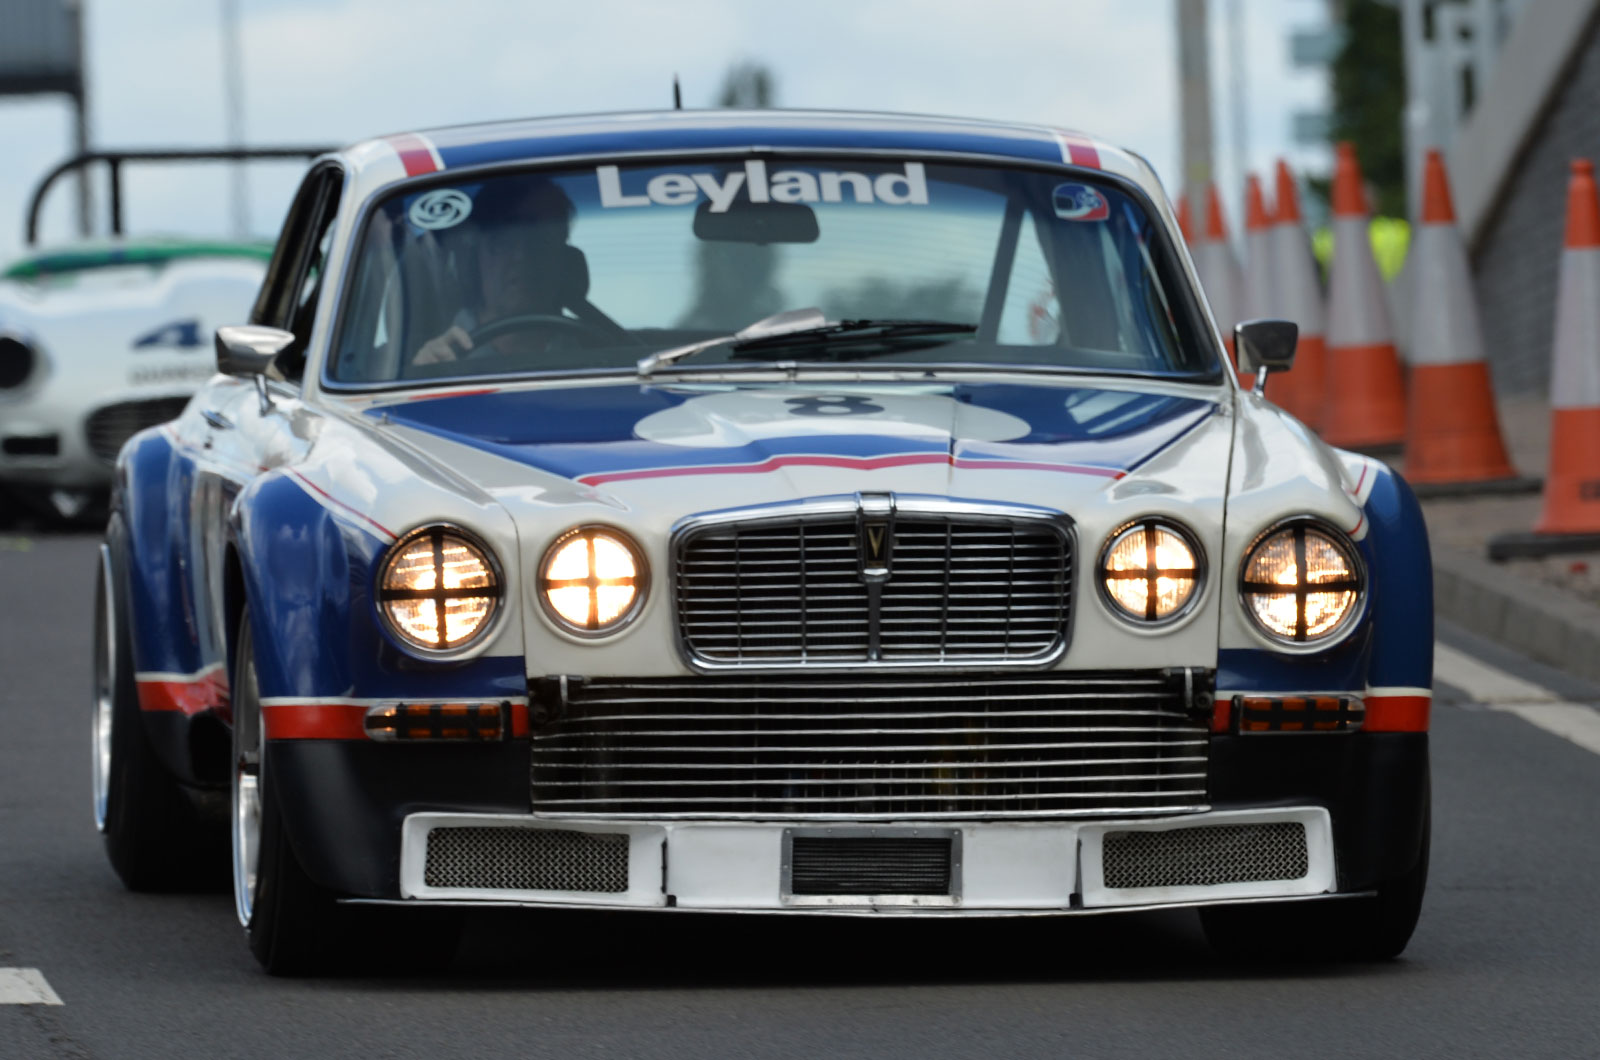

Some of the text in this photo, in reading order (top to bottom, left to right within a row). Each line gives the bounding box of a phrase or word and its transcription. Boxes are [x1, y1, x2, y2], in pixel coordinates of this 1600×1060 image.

[597, 159, 929, 212] Leyland
[131, 320, 205, 350] 4
[783, 395, 885, 417] 8
